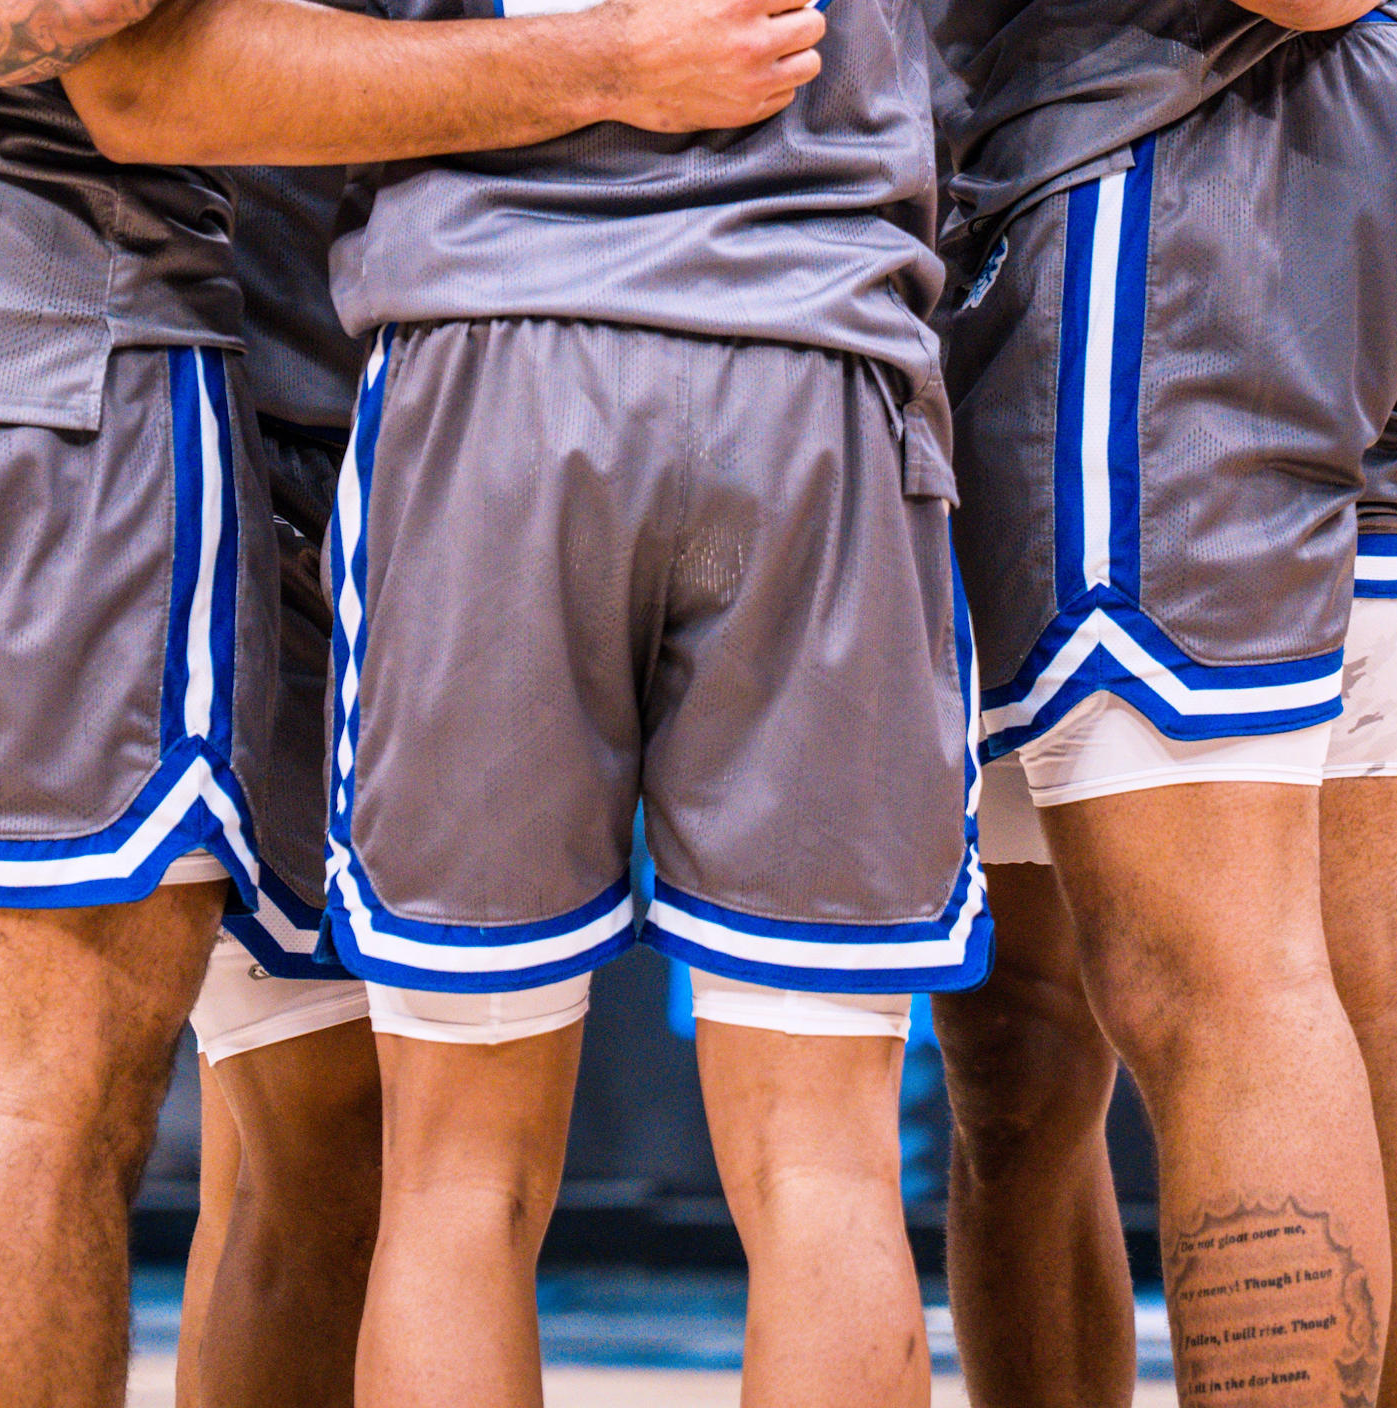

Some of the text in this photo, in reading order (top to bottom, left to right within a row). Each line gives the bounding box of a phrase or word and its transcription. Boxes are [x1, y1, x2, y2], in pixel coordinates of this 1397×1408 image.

[1197, 1237, 1215, 1250] not
[1252, 1228, 1280, 1240] over
[1244, 1272, 1292, 1291] Though
[1232, 1326, 1256, 1341] will
[1291, 1314, 1336, 1333] Though
[1209, 1379, 1222, 1393] in
[1225, 1377, 1245, 1392] the
